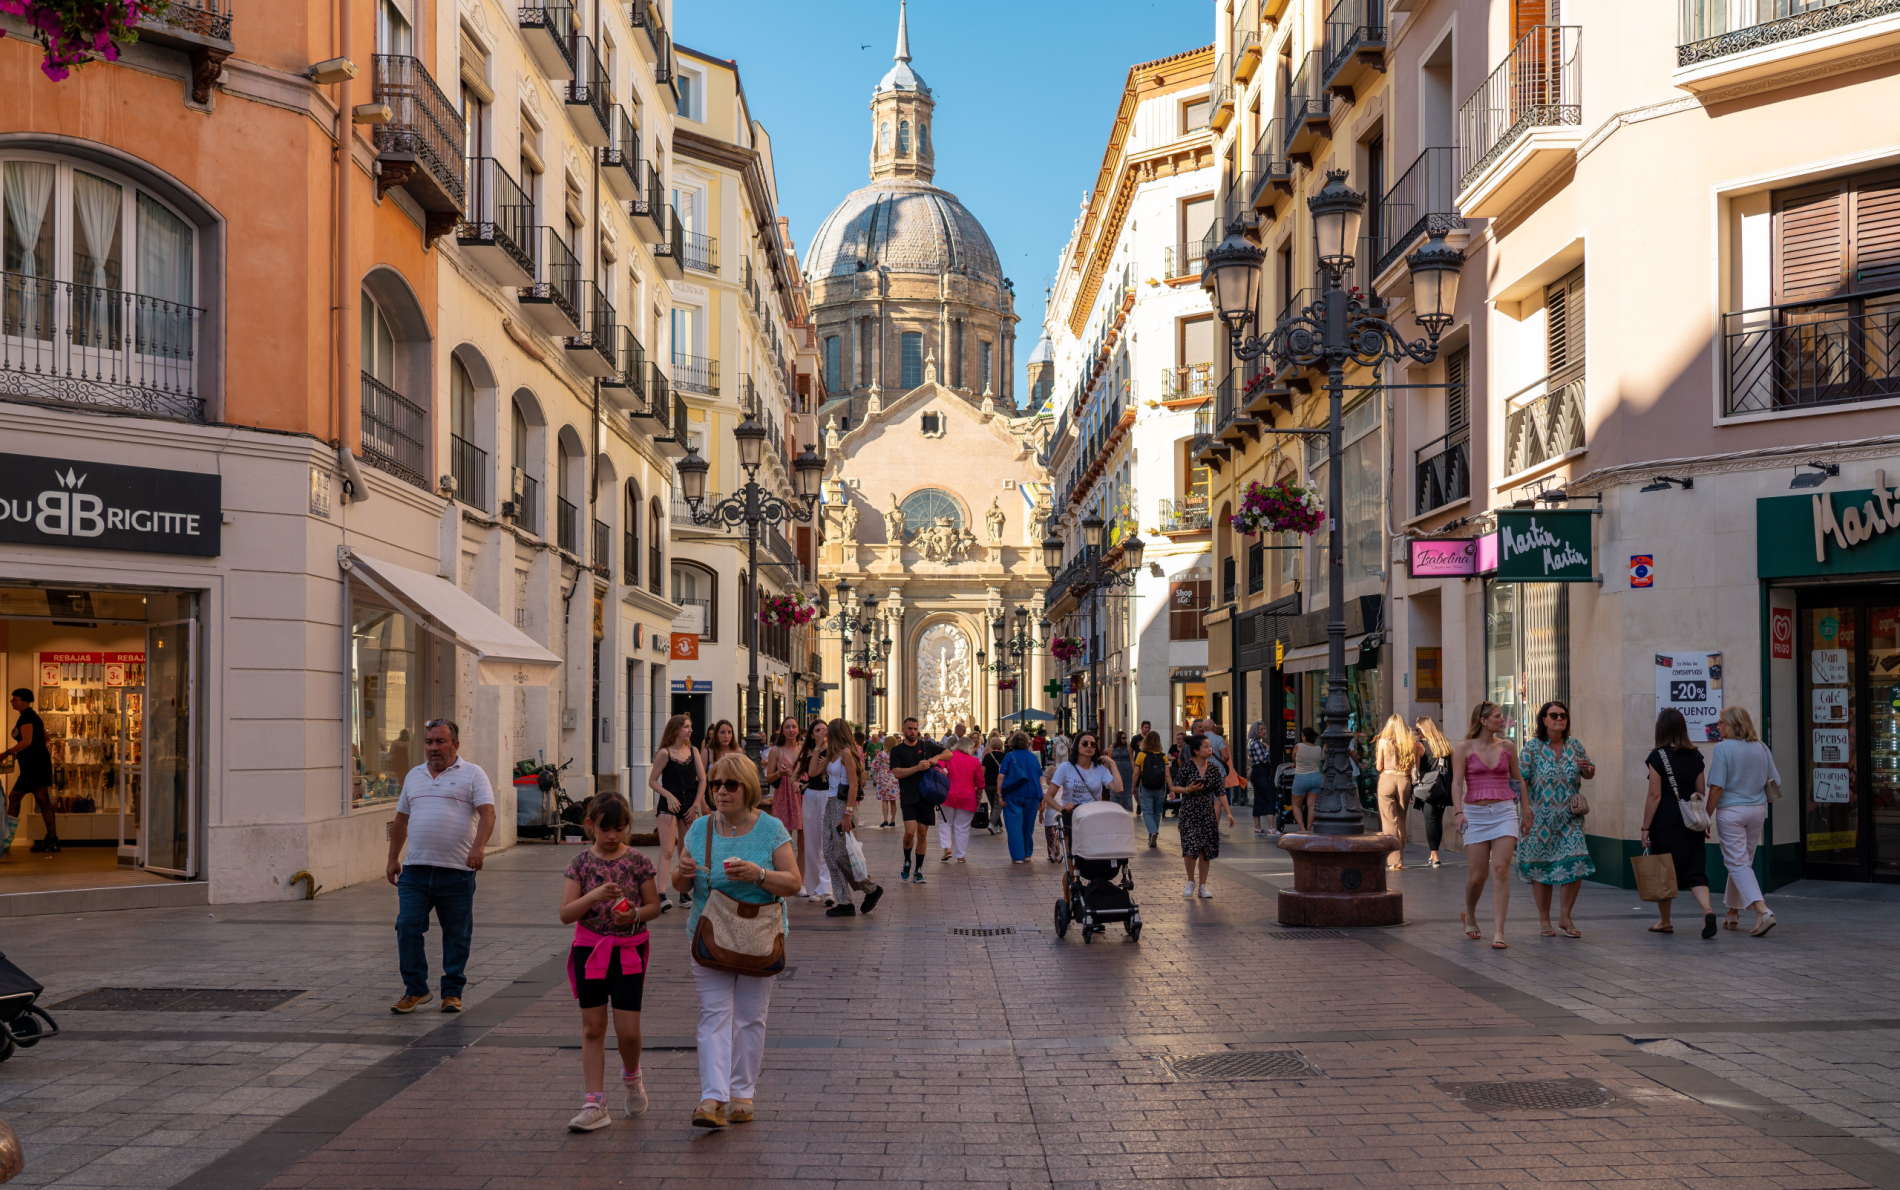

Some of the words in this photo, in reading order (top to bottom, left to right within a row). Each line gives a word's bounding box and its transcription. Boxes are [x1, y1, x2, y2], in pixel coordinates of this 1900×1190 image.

[1416, 549, 1470, 568] Isabelina
[1175, 589, 1193, 599] Shop
[1775, 643, 1789, 653] FRIGO
[1821, 650, 1839, 663] Pan
[46, 671, 57, 680] 1€
[109, 671, 120, 680] 3€
[1672, 683, 1706, 700] -20%
[1820, 690, 1841, 704] Café
[1814, 732, 1847, 744] Prensa
[1814, 770, 1848, 782] Recargas
